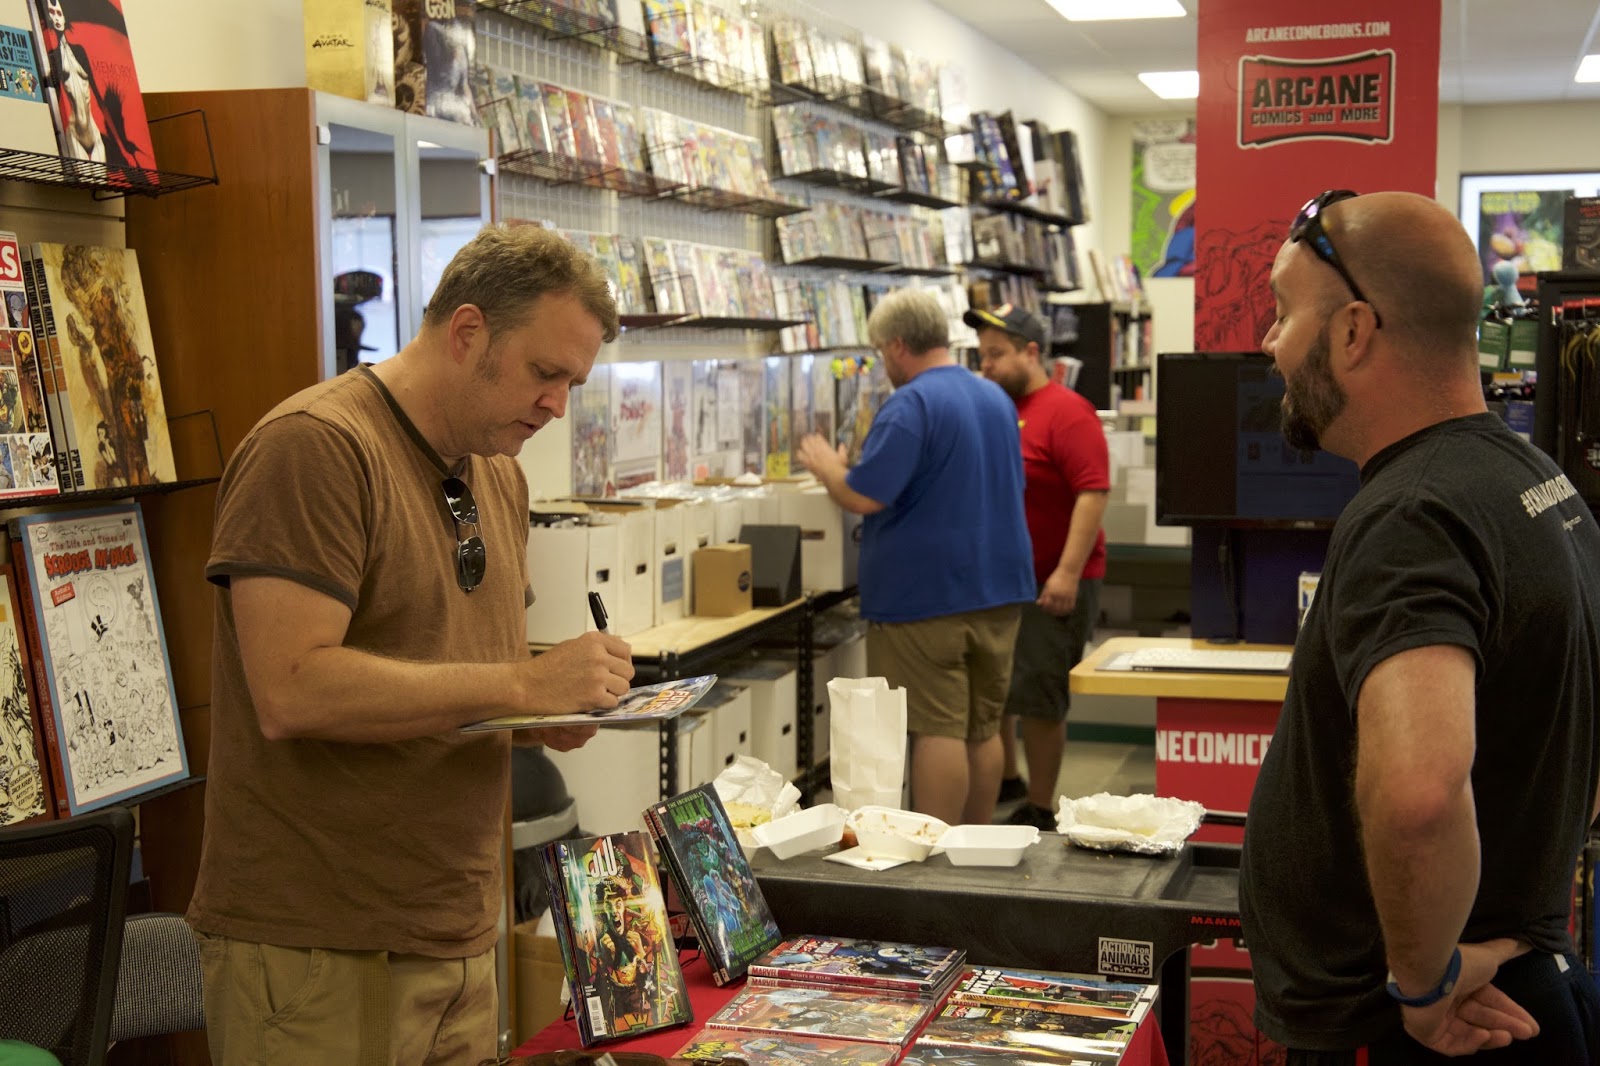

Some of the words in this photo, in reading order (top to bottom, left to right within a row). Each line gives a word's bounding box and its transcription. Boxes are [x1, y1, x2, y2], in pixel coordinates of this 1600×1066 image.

[1246, 21, 1390, 43] ARCANECOMICBOOKS.COM
[312, 38, 354, 48] AVATAR
[1252, 73, 1382, 108] ARCANE
[1251, 109, 1302, 126] COMICS
[1309, 109, 1334, 123] and
[1341, 106, 1380, 122] MORE
[50, 541, 64, 552] The
[65, 539, 81, 549] Life
[82, 537, 96, 547] and
[97, 534, 117, 544] Times
[44, 549, 92, 581] SCROOGE
[669, 797, 712, 830] HULK
[590, 836, 617, 878] JLU
[1102, 940, 1135, 953] ACTION
[1135, 946, 1150, 955] FOR
[1101, 951, 1150, 967] ANIMALS
[751, 966, 778, 976] MARVEL
[751, 977, 778, 988] MARVEL
